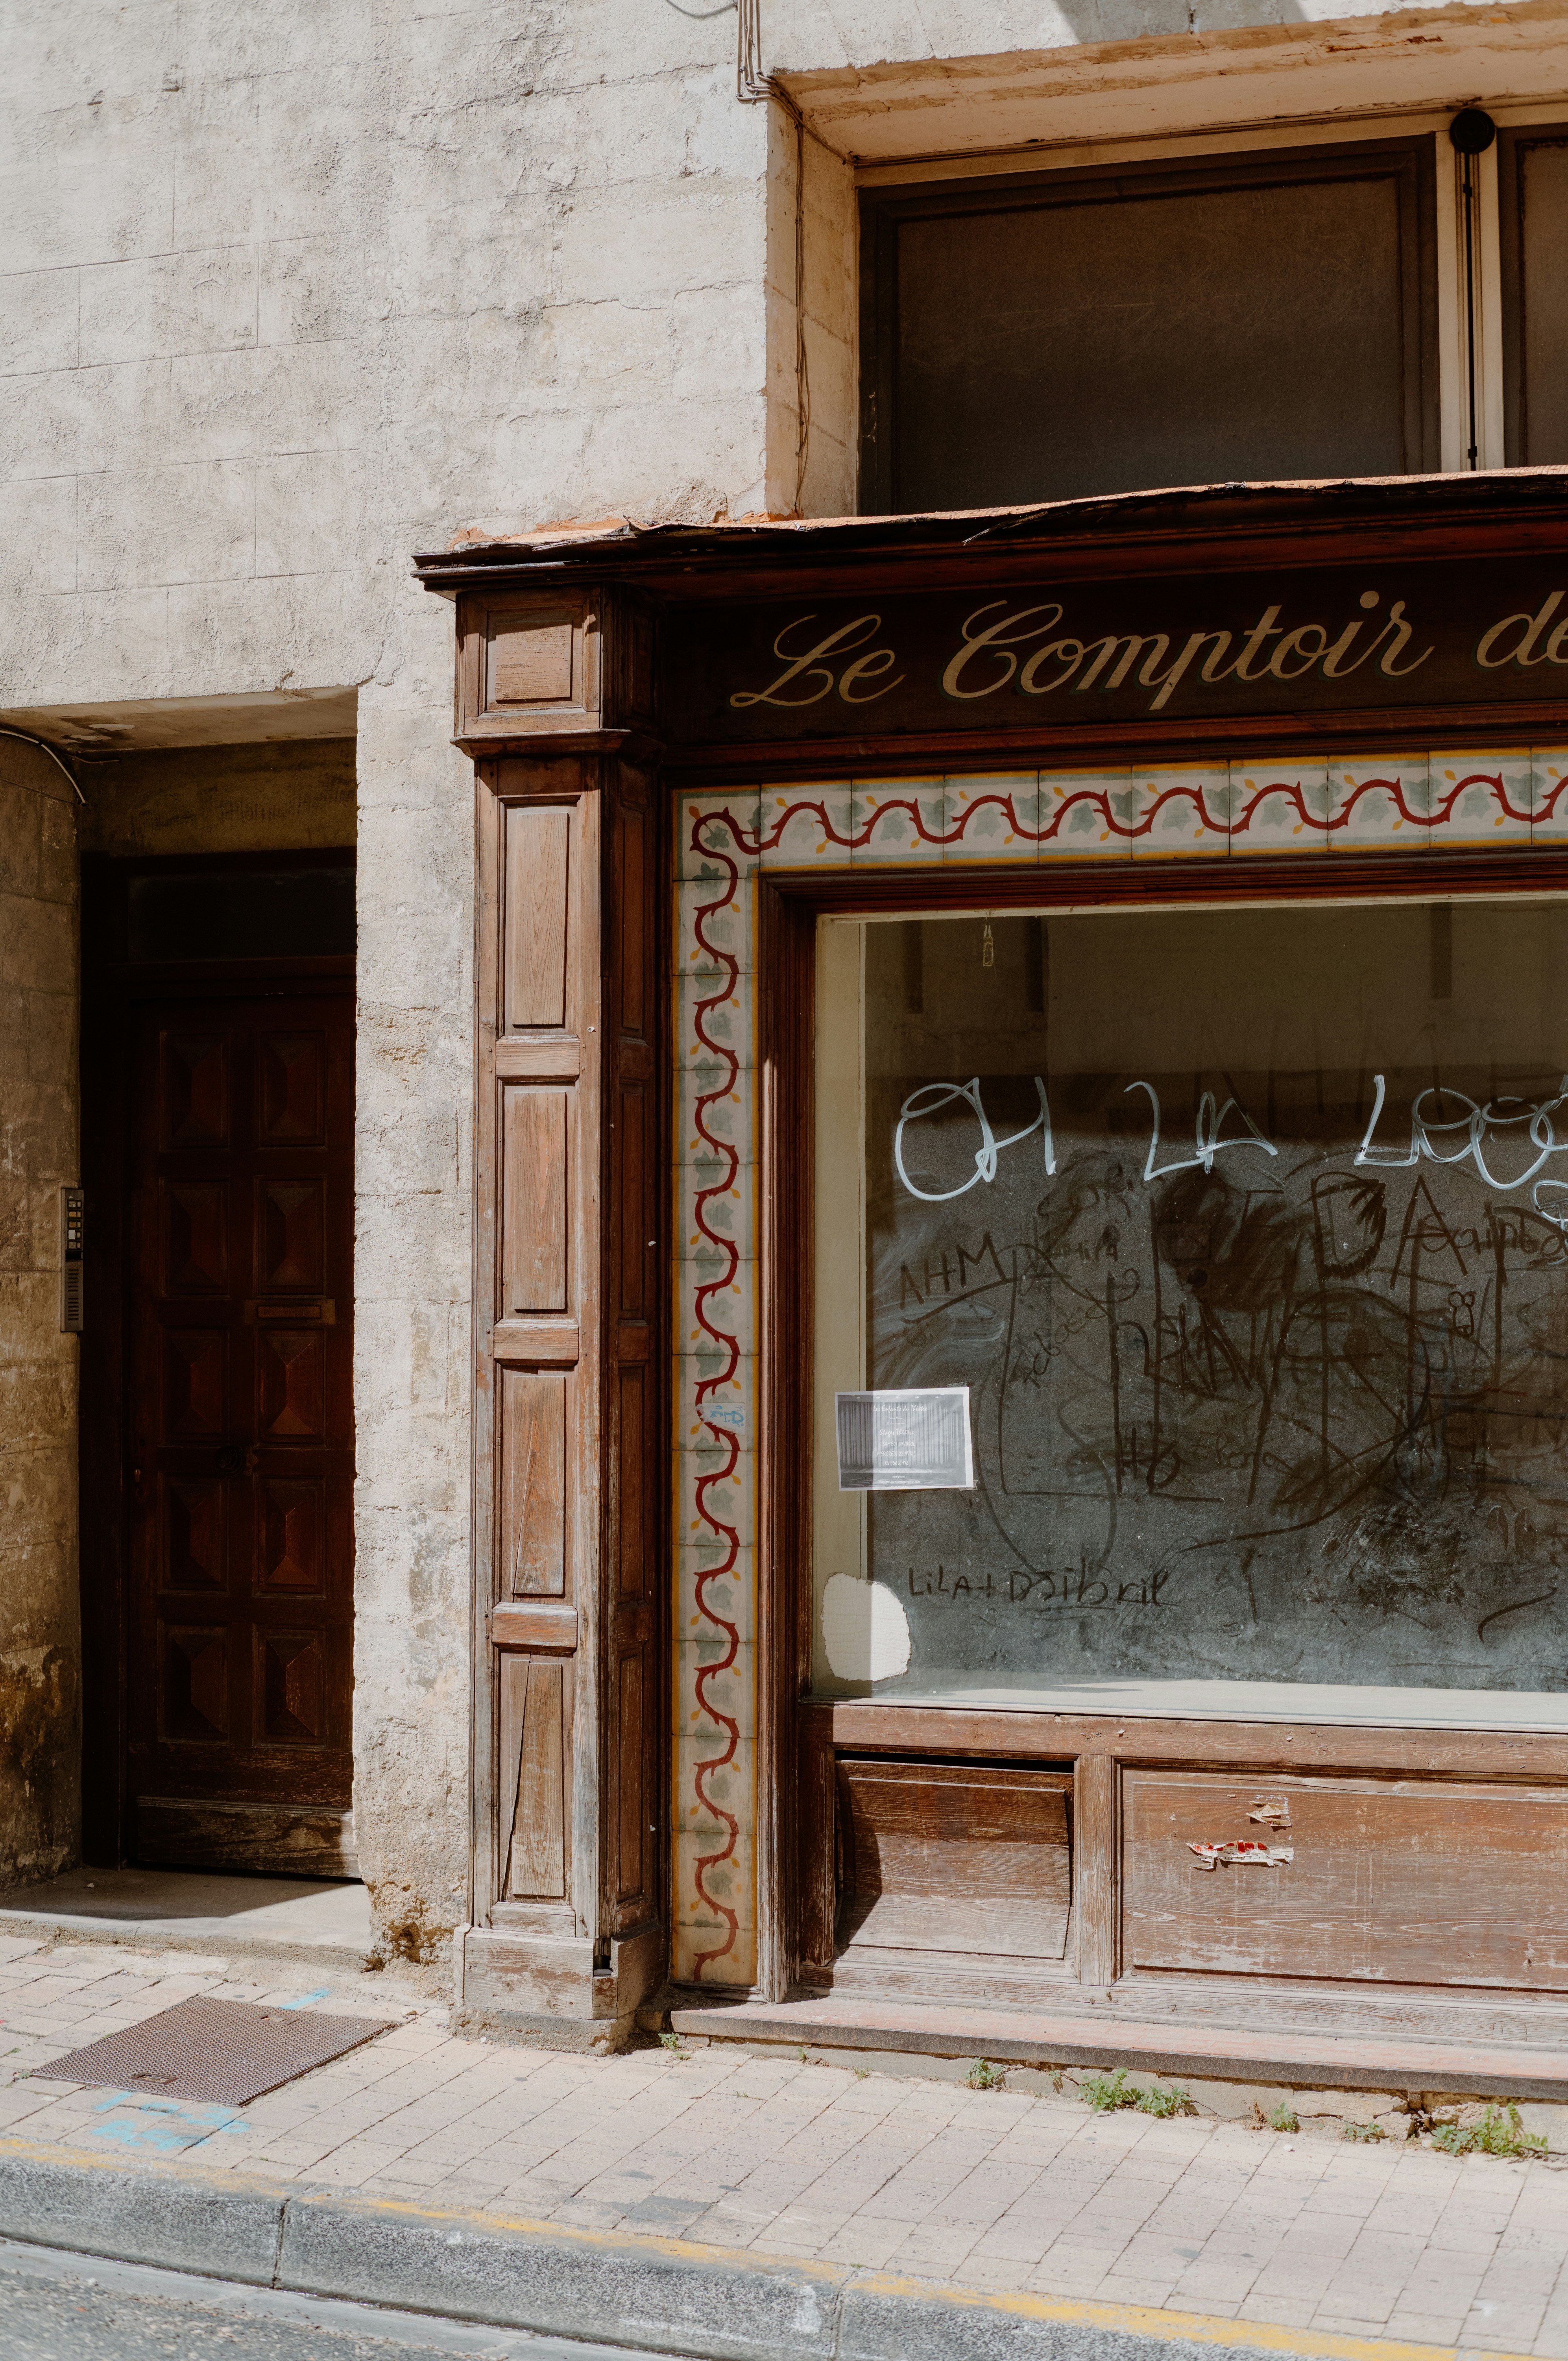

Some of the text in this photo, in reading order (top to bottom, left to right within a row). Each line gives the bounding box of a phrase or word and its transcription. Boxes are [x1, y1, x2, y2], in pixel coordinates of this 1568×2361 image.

[730, 614, 906, 708] Le
[942, 591, 1434, 710] Comptoir
[881, 1405, 902, 1413] Enfants
[879, 1428, 895, 1439] Stages
